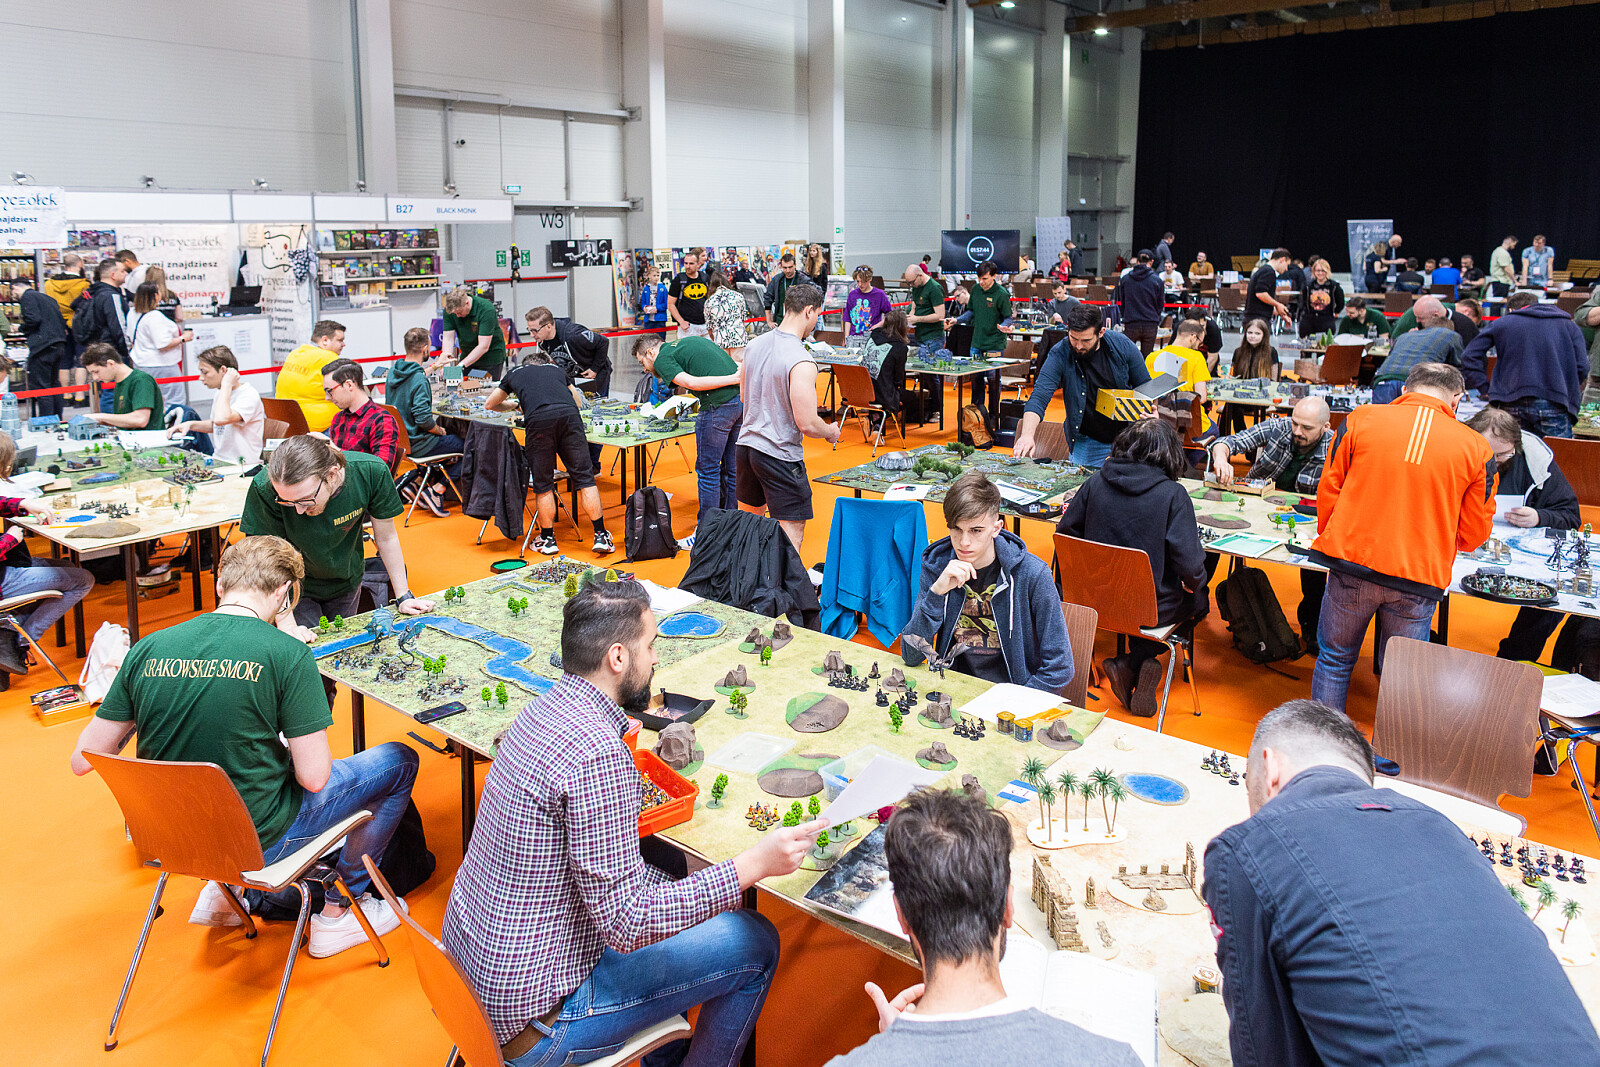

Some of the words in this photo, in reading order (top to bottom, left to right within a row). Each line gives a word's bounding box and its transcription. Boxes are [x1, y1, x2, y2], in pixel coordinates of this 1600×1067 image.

[396, 205, 413, 213] B27
[540, 213, 564, 228] W3
[142, 658, 219, 678] KRAKOWSKIE
[216, 658, 264, 682] SMOKI
